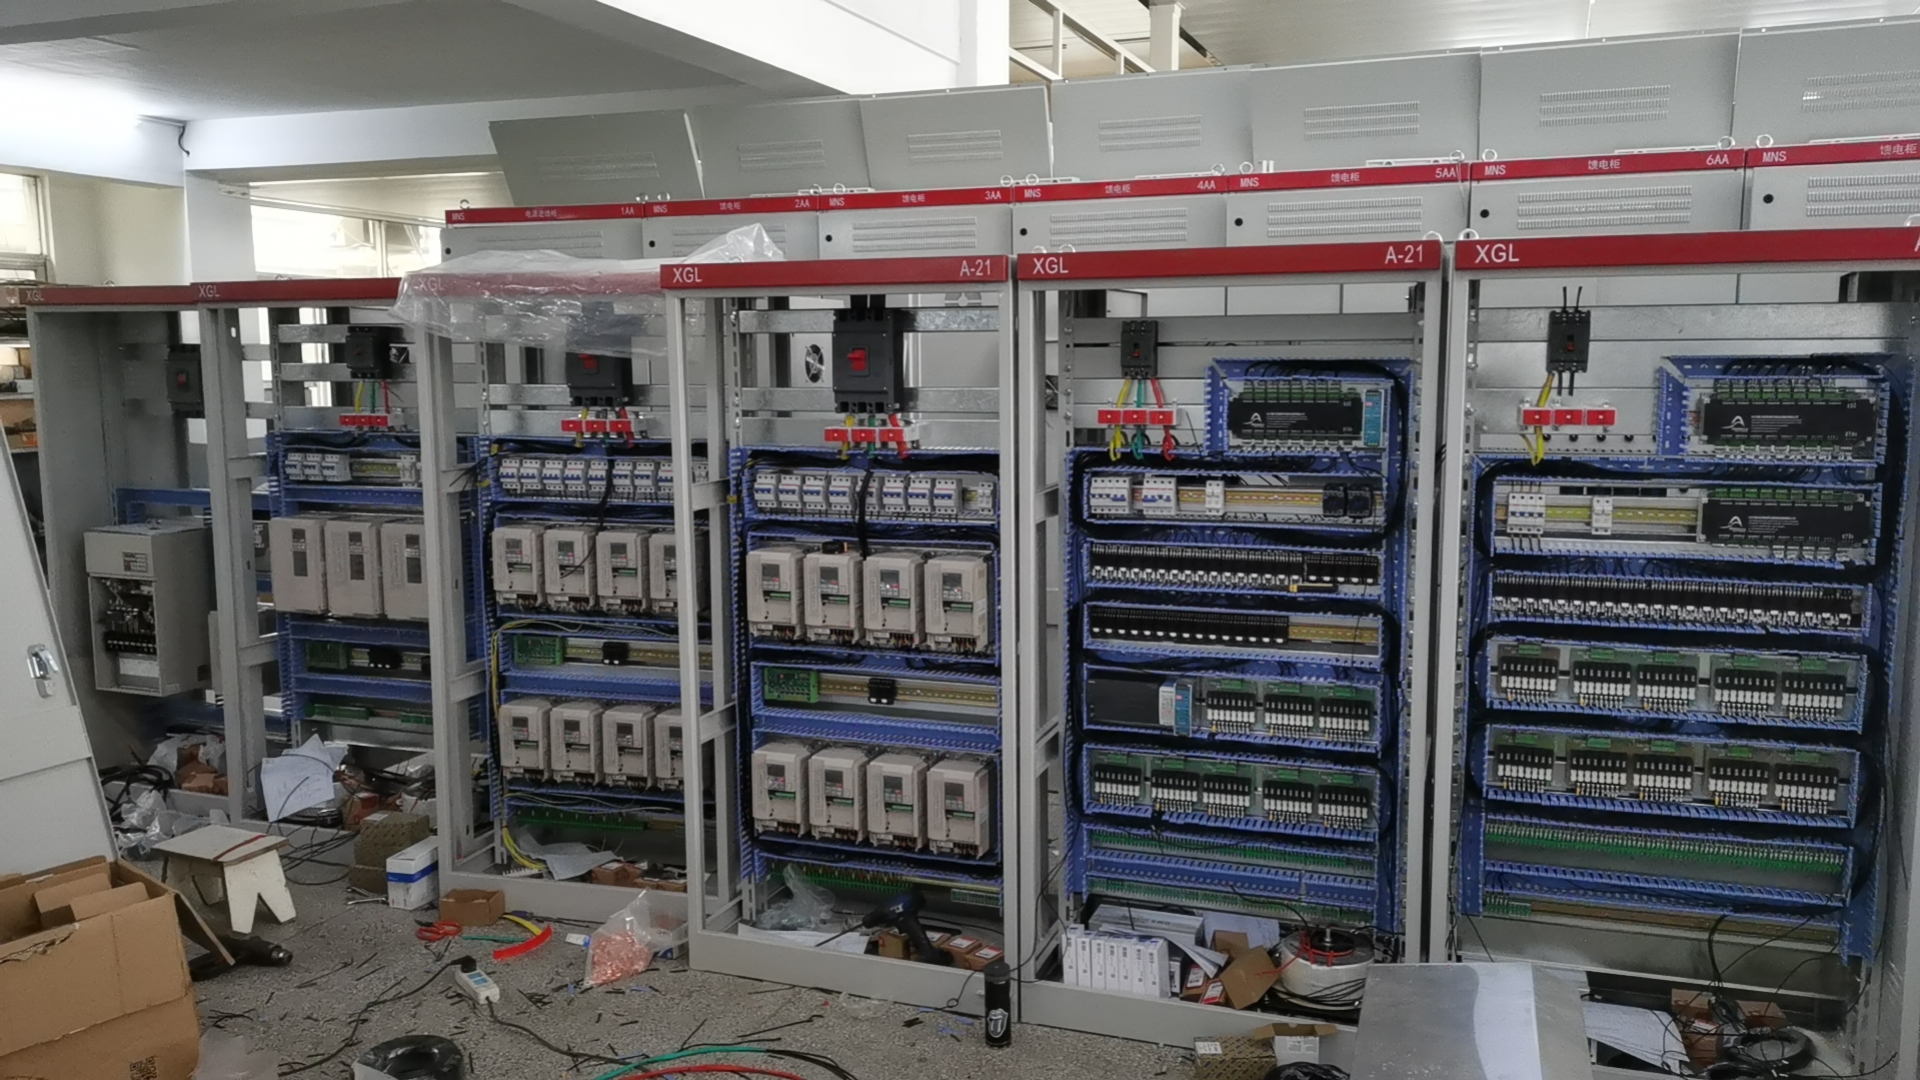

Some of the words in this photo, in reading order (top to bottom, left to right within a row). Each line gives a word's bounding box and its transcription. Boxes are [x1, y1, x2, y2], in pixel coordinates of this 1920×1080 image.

[1706, 154, 1730, 165] 6AA
[1762, 150, 1787, 162] MNS
[1434, 168, 1457, 178] 5AA
[1484, 164, 1506, 176] MNS
[1197, 180, 1216, 190] 4AA
[1239, 177, 1260, 187] MNS
[985, 190, 1002, 200] 3AA
[1024, 188, 1042, 198] MNS
[795, 199, 811, 208] 2AA
[829, 197, 845, 206] MNS
[621, 206, 636, 216] 1AA
[653, 205, 668, 213] MNS
[1385, 245, 1424, 264] A-21
[1475, 244, 1520, 264] XGL
[959, 258, 992, 276] A-21
[1032, 256, 1069, 275] XGL
[672, 266, 703, 284] XGL
[26, 288, 45, 302] XGL
[199, 284, 220, 298] XGL
